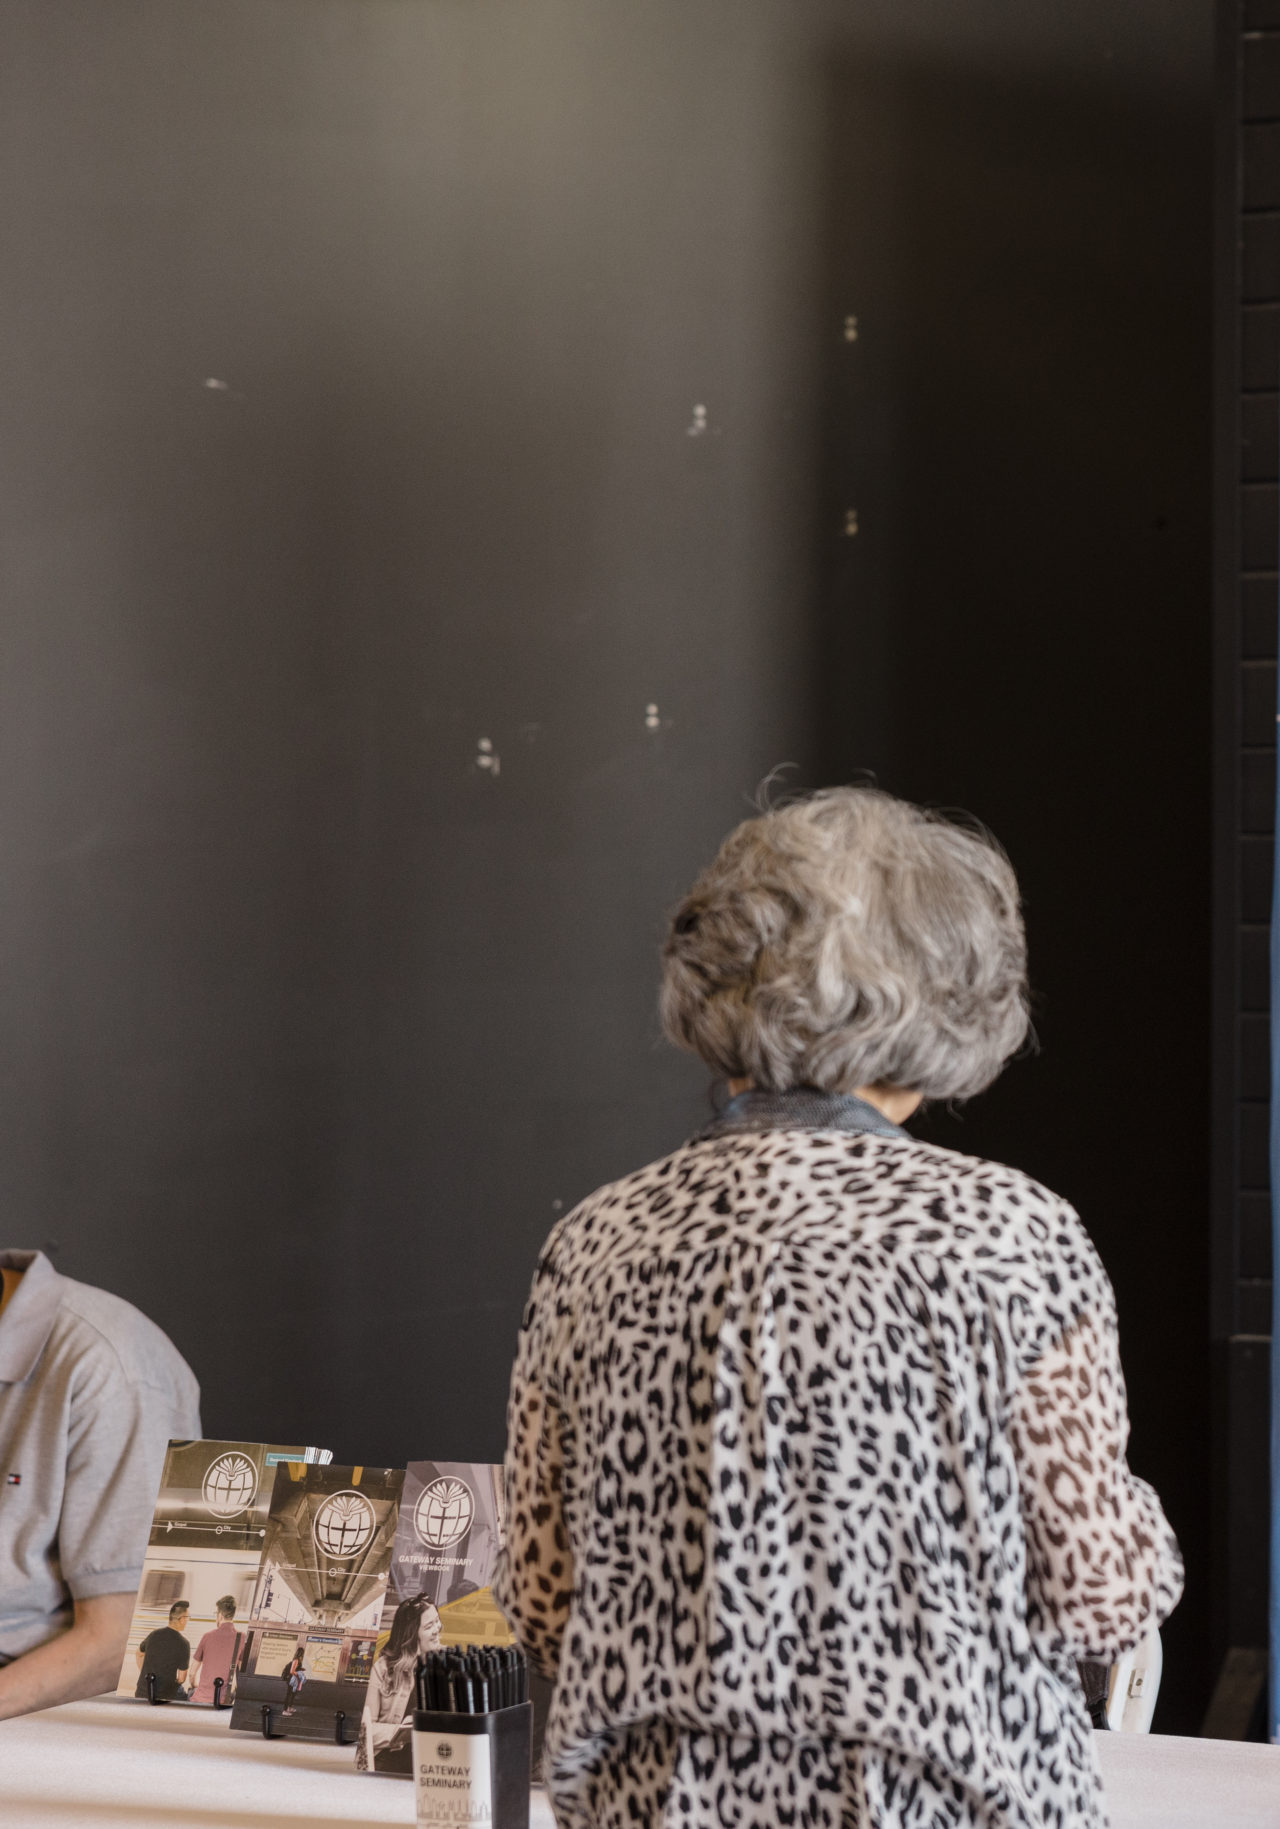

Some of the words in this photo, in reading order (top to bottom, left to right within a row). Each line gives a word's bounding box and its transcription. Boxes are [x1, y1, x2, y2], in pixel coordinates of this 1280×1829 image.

[398, 1555, 435, 1565] GATEWAY
[435, 1556, 474, 1567] SEMINARY
[419, 1564, 450, 1573] VIEWBOOK
[420, 1764, 471, 1777] GATEWAY
[420, 1777, 472, 1790] SEMINARY
